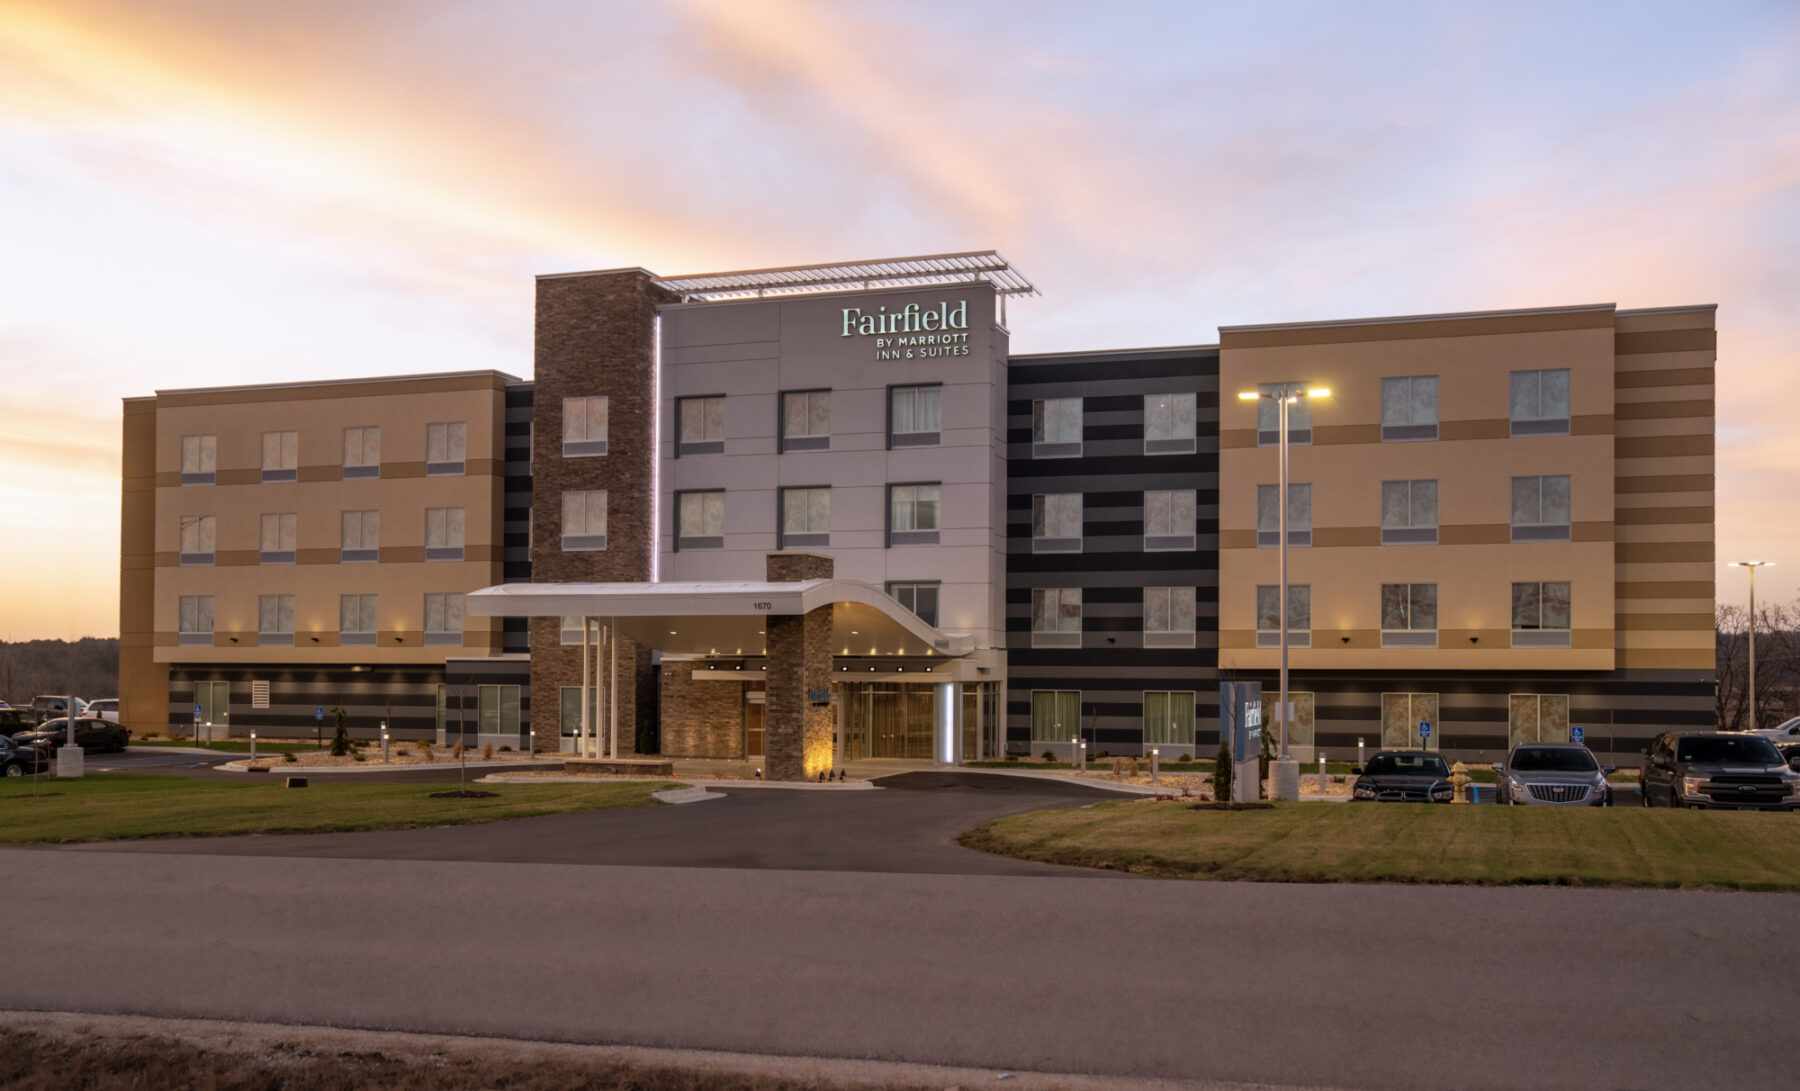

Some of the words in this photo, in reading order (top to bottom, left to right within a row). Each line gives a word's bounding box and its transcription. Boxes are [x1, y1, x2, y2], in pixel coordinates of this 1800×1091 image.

[841, 300, 969, 337] Fairfield
[877, 338, 893, 348] BY
[898, 333, 969, 347] MARRIOTT
[876, 350, 901, 361] INN
[906, 348, 914, 359] &
[920, 345, 969, 358] SUITES
[753, 602, 772, 610] 1670
